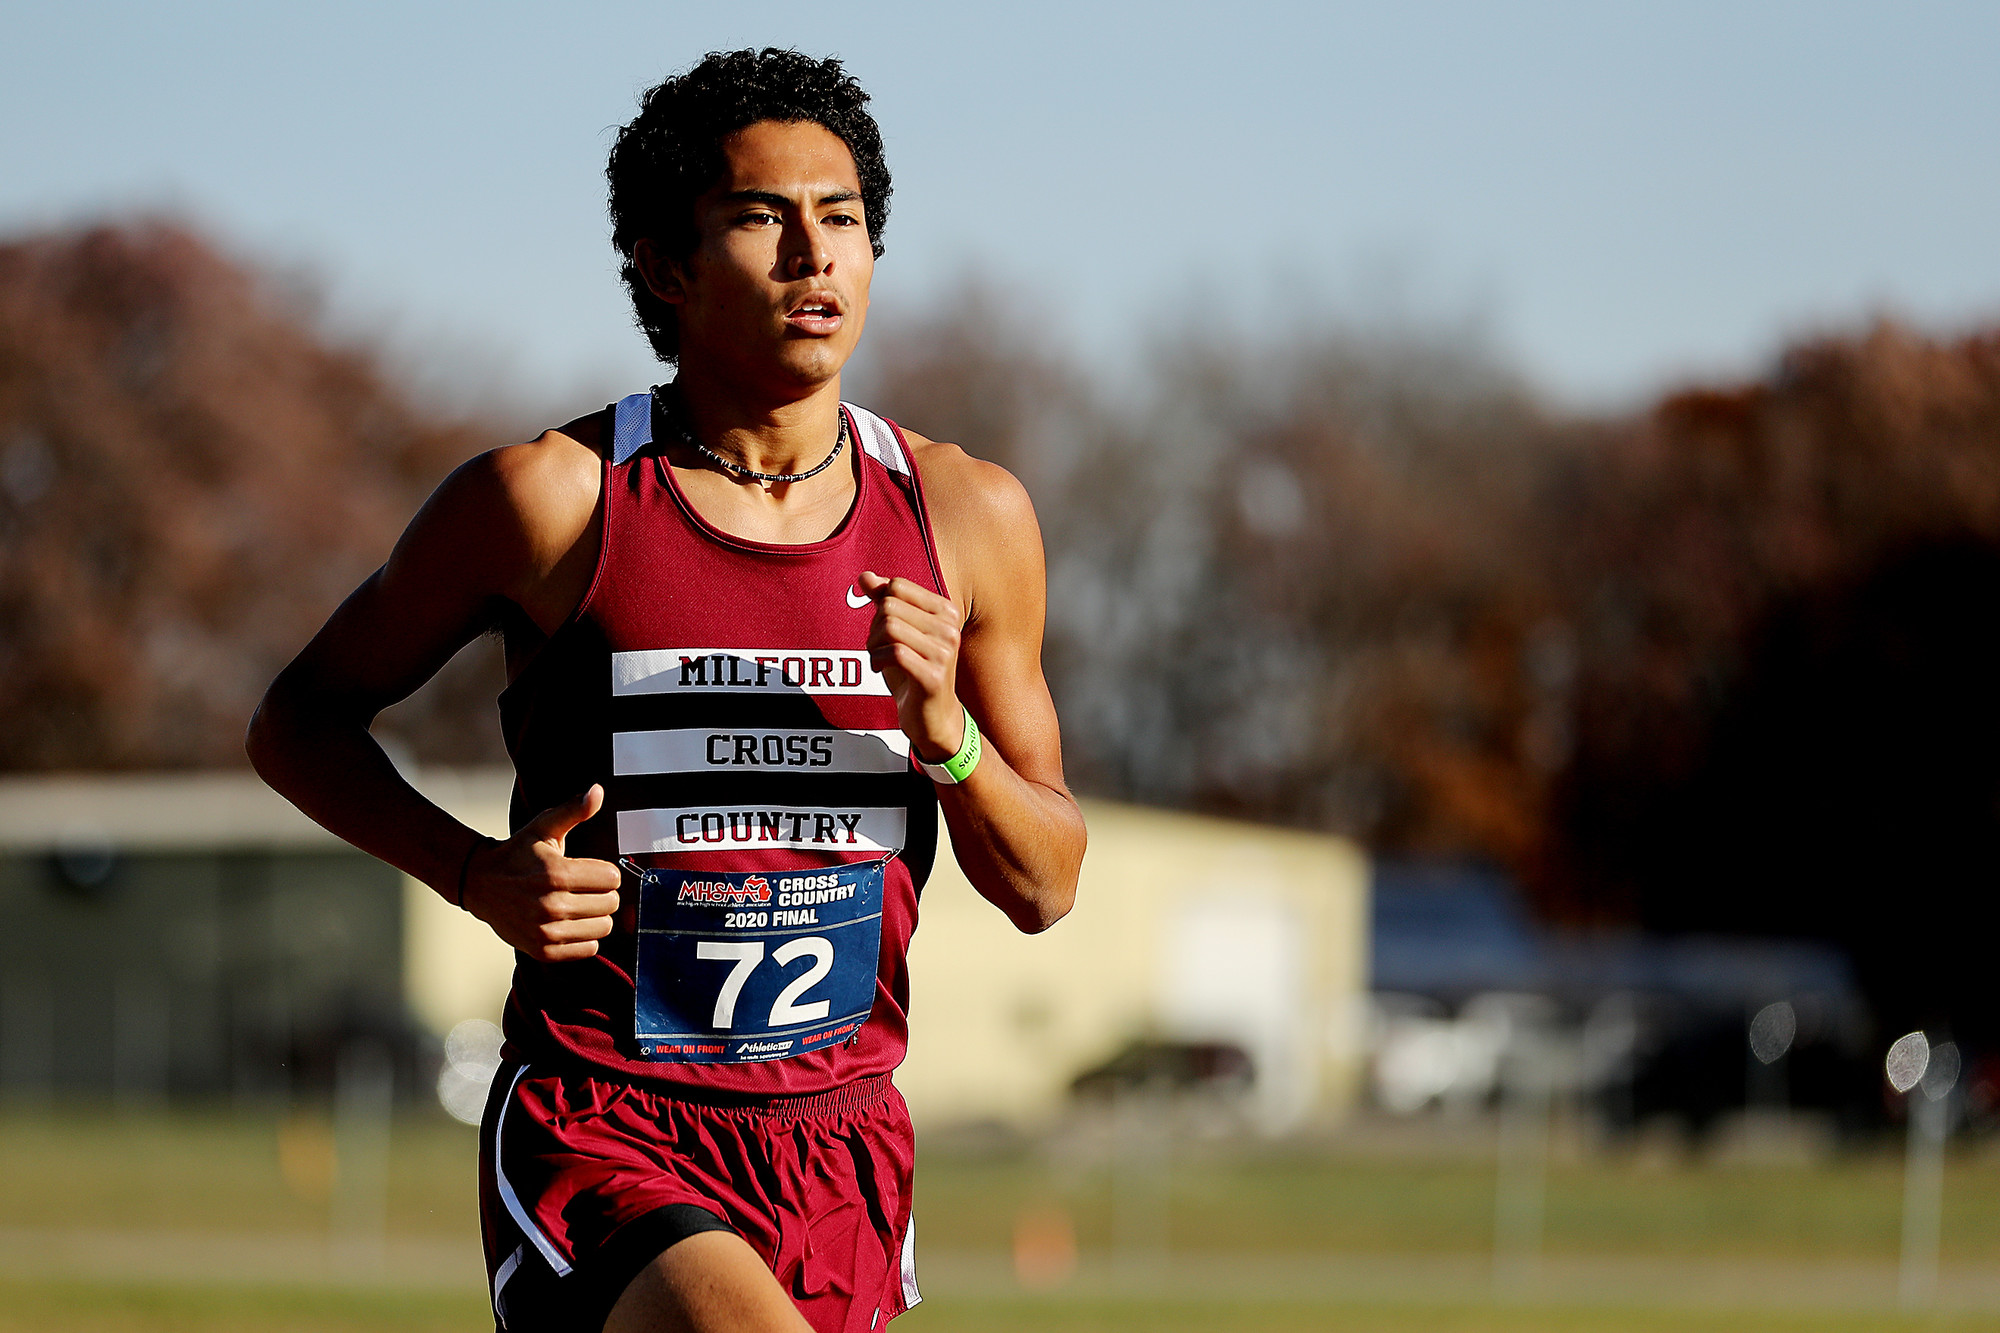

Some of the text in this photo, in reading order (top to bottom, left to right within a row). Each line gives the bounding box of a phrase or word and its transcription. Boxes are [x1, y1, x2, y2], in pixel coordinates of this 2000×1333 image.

[678, 656, 862, 687] MILFORD
[706, 734, 833, 766] CROSS
[675, 811, 862, 843] COUNTRY
[678, 880, 759, 902] MHSAA
[779, 873, 839, 892] CROSS
[778, 883, 857, 907] COUNTRY
[724, 908, 819, 929] 2020 FINAL
[697, 936, 835, 1029] 72
[802, 1023, 855, 1045] WEAR ON FRONT
[656, 1044, 726, 1054] WEAR ON FRONT
